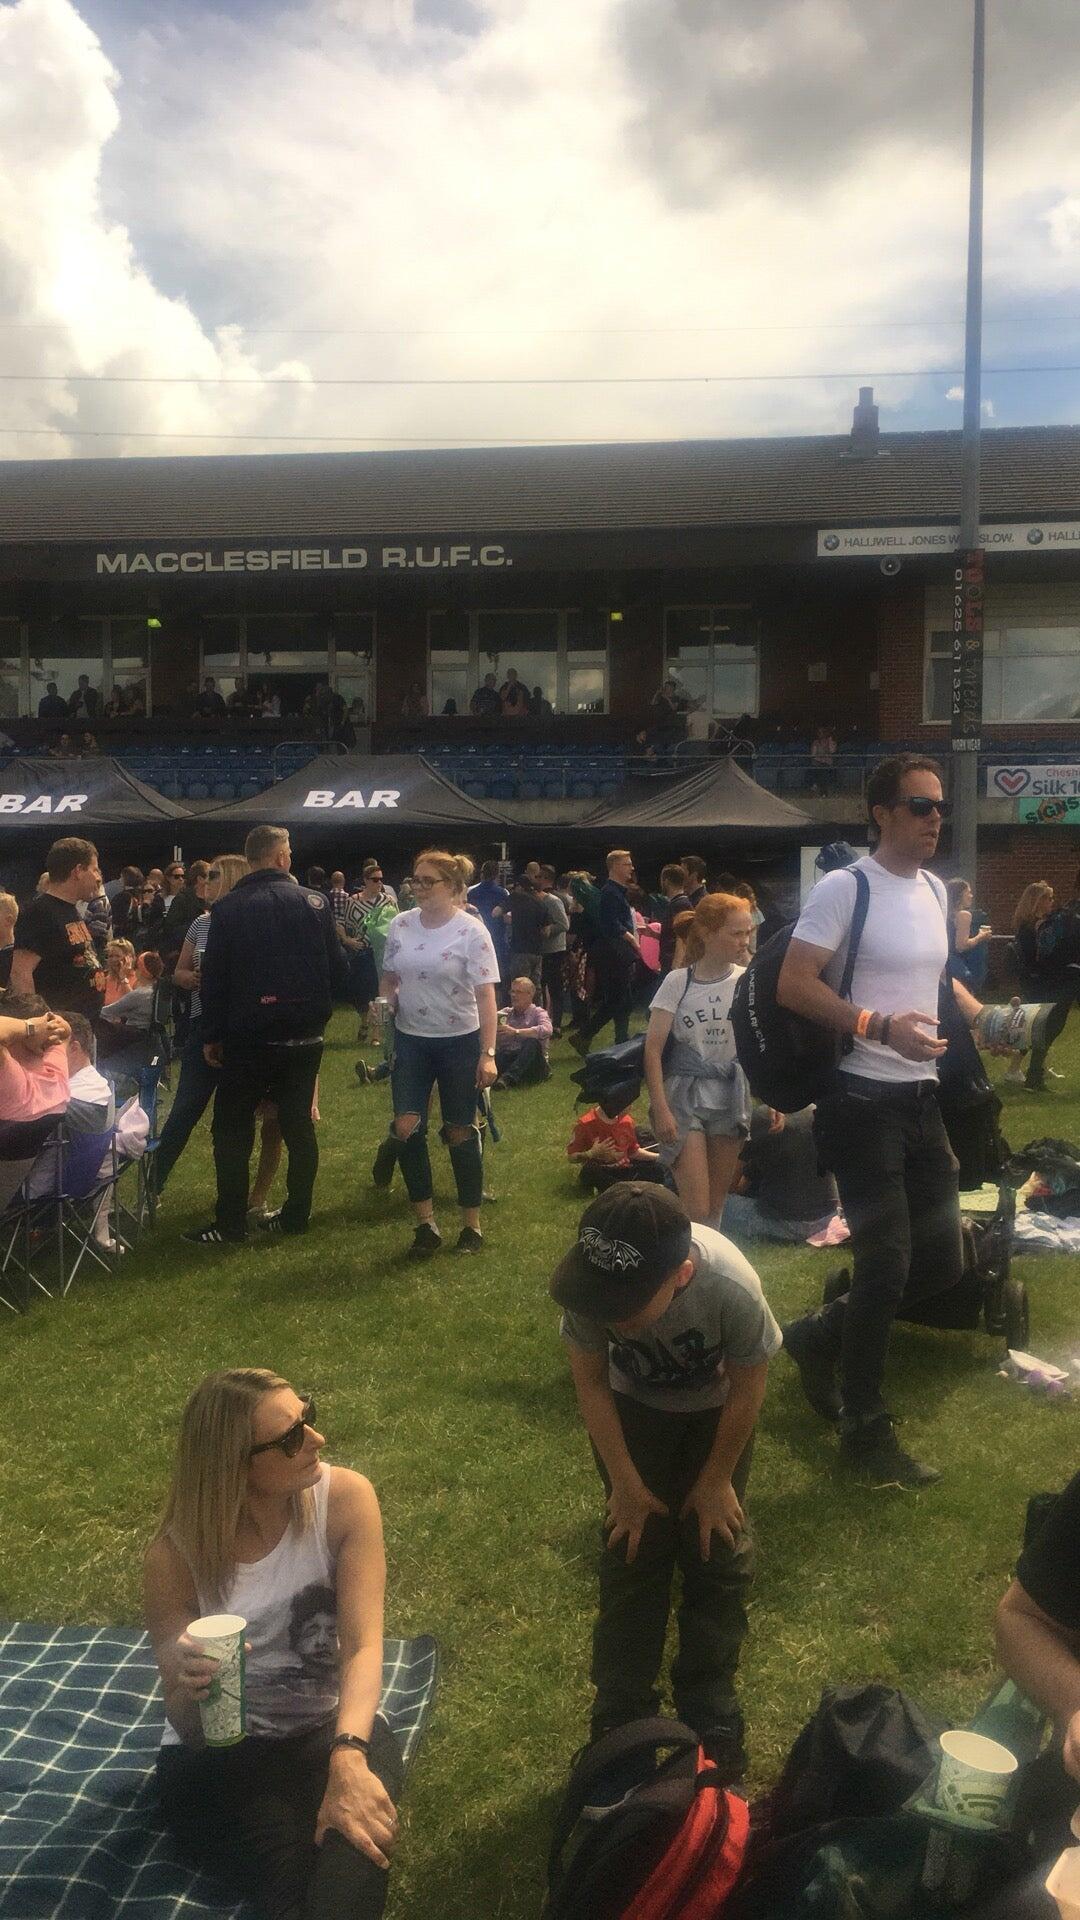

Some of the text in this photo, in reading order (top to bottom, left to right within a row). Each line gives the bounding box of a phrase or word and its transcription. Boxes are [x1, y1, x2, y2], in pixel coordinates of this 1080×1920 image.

[844, 533, 1015, 548] HALLIWELL JONES WSLOW.
[96, 545, 513, 573] MACCLESFIELD R.U.F.C.
[953, 569, 962, 714] 01625 611324
[1032, 780, 1067, 796] Silk
[0, 794, 88, 813] BAR
[303, 790, 400, 808] BAR
[708, 995, 721, 1003] LA
[683, 1008, 733, 1028] BELL
[706, 1028, 725, 1036] VITA
